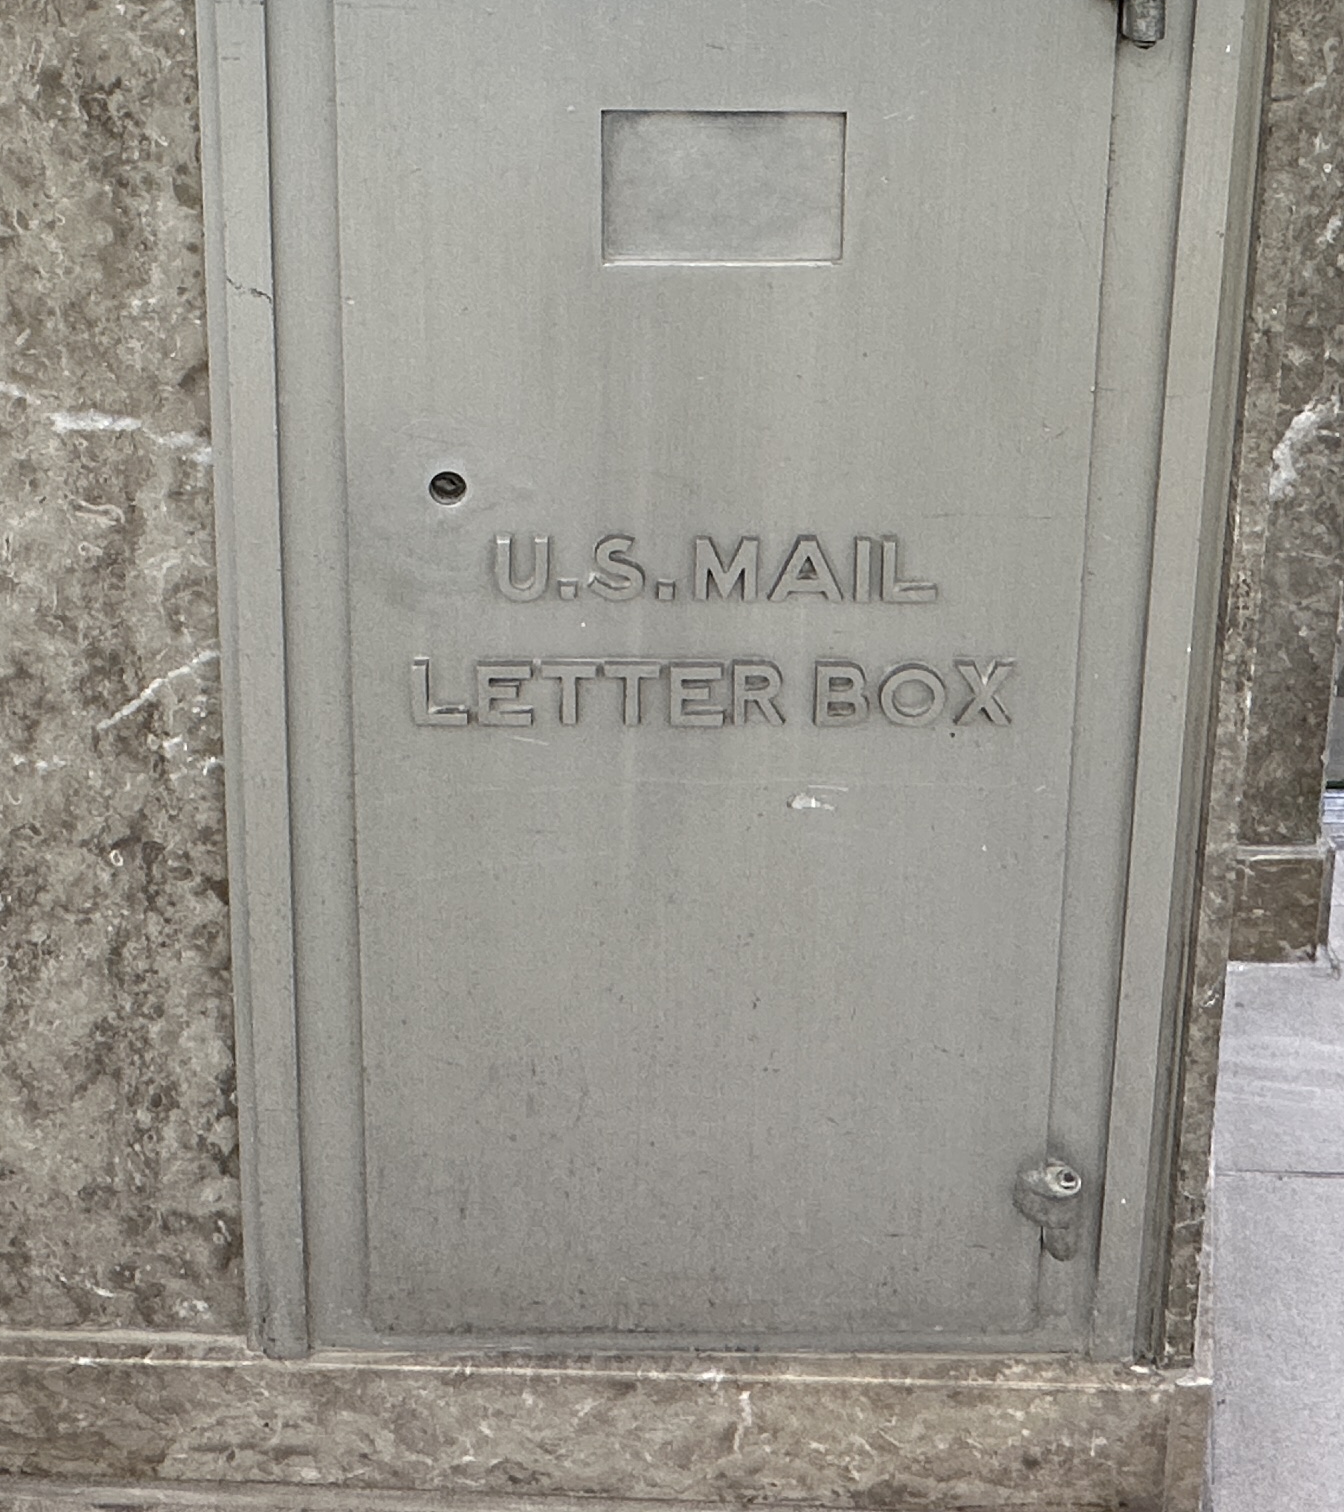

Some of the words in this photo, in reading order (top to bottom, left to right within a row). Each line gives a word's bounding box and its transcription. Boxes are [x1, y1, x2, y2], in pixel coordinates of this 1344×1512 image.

[693, 535, 938, 603] MAIL
[410, 657, 786, 727] LETTER
[813, 659, 1016, 728] BOX
